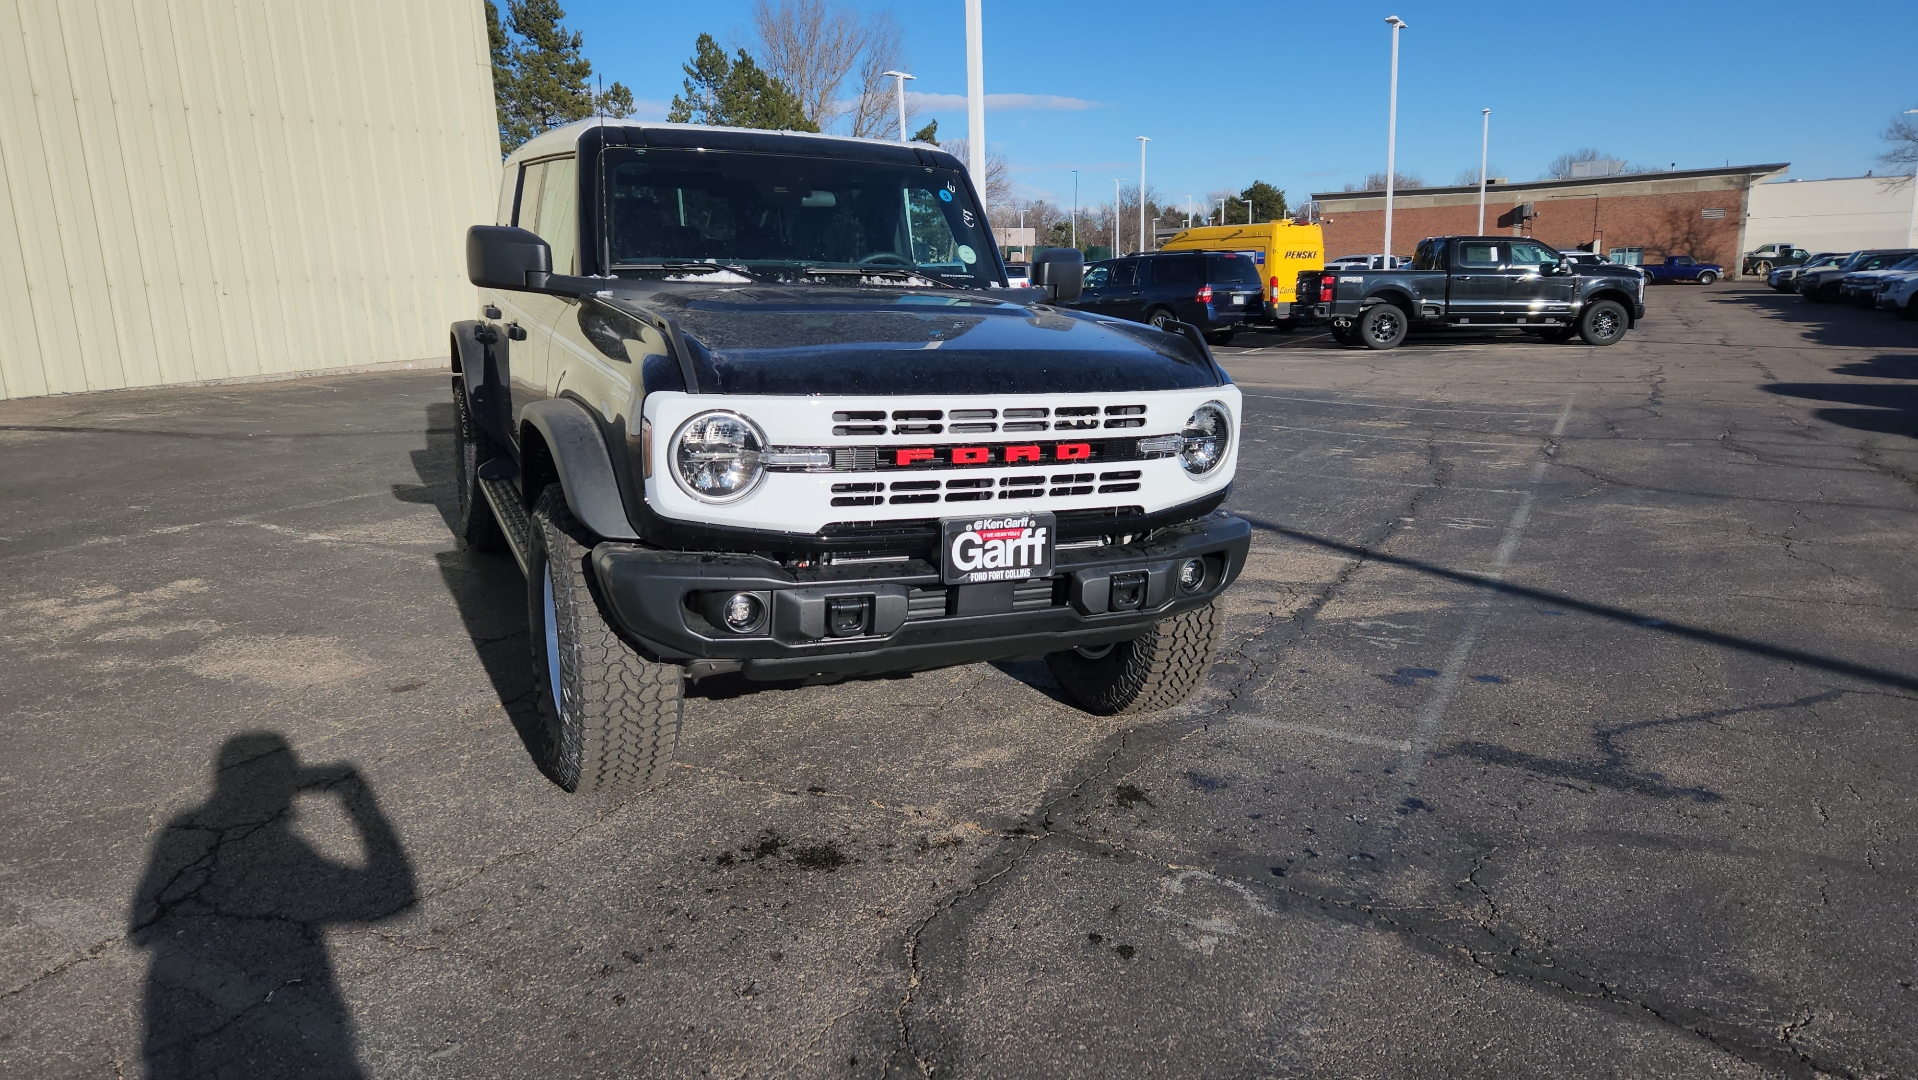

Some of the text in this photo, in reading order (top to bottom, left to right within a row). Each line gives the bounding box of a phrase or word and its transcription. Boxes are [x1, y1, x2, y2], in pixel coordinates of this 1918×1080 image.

[1284, 250, 1318, 260] PENSKE
[896, 443, 1091, 467] FORD
[983, 516, 1029, 530] Ken Garff
[951, 527, 1047, 572] Garff
[970, 567, 1031, 582] FORD FORT COLLINS
